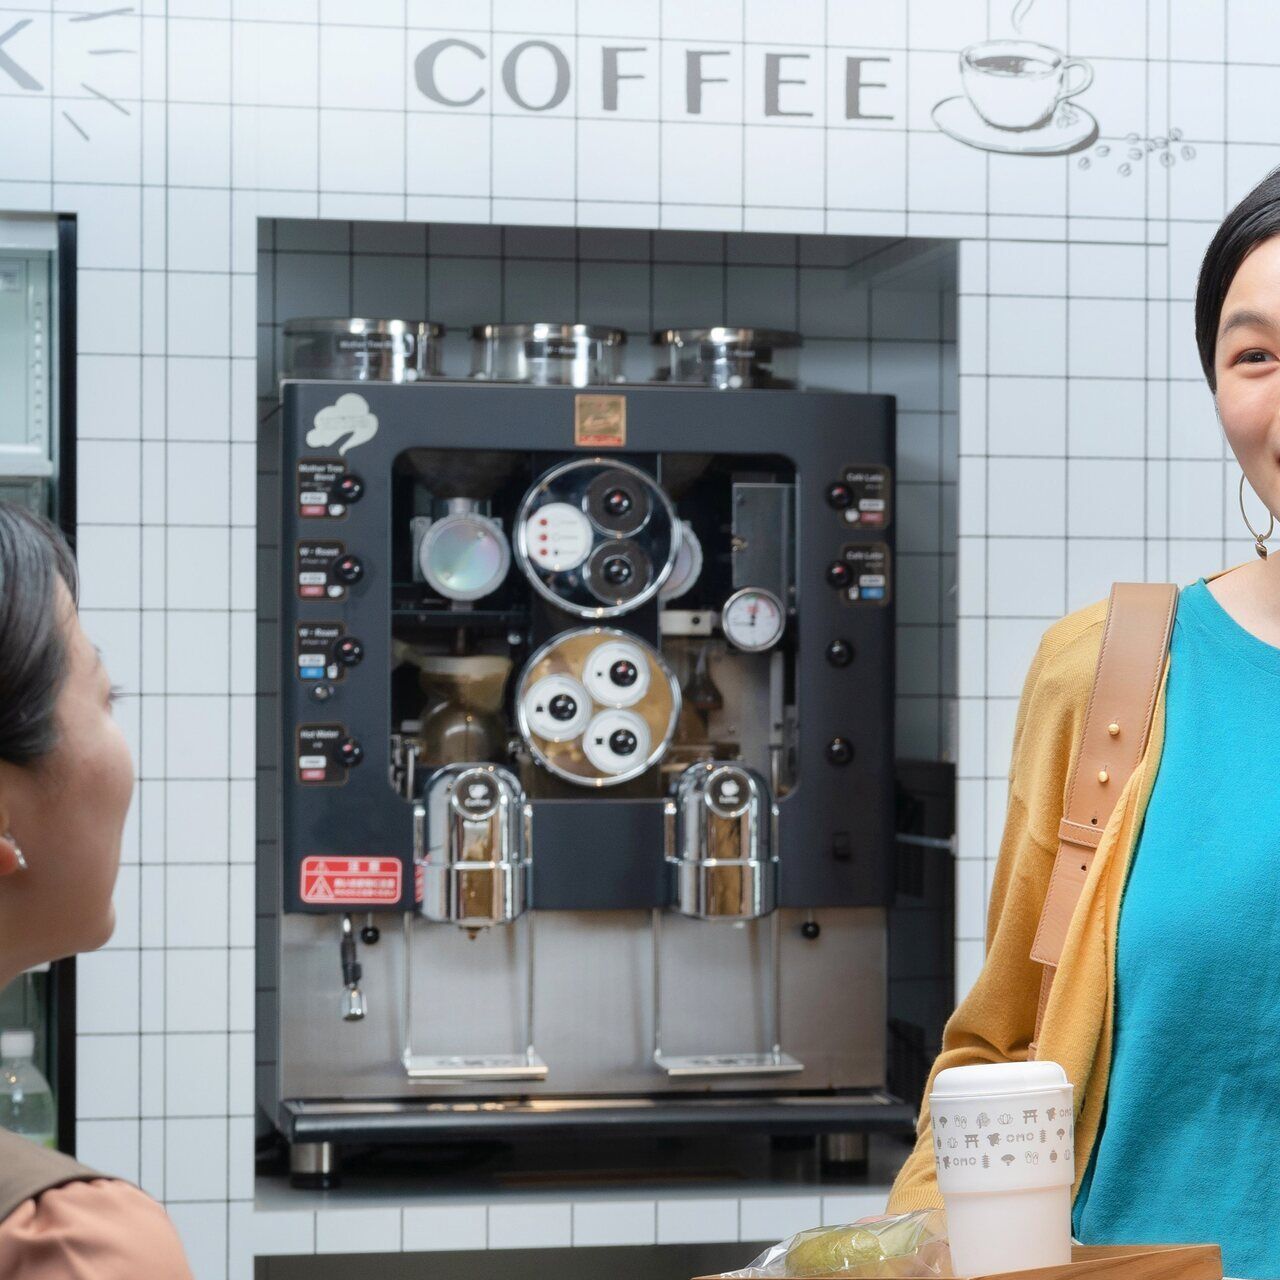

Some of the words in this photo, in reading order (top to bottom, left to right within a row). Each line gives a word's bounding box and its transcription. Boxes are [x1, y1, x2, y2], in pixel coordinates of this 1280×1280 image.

[414, 38, 894, 121] COFFEE
[1006, 1132, 1034, 1143] OMO
[953, 1157, 976, 1167] OMO
